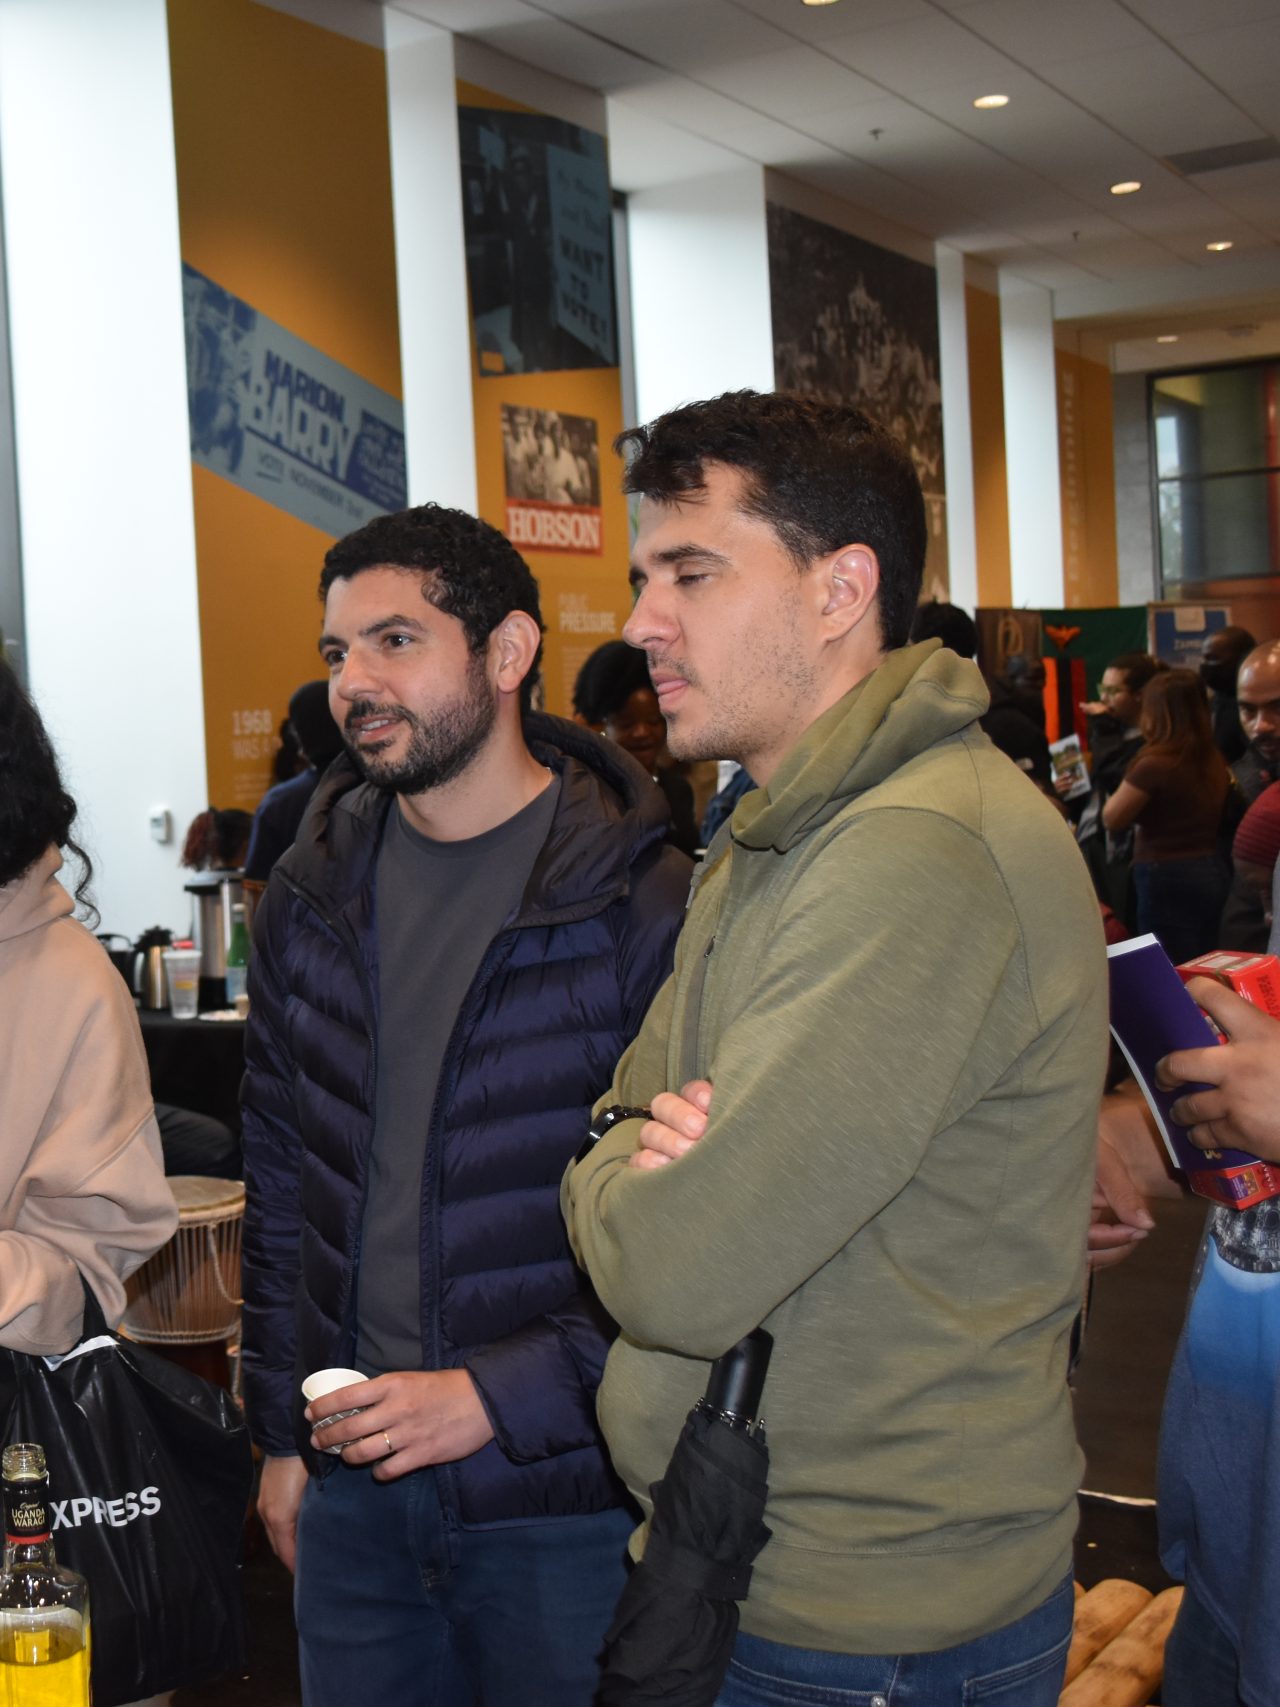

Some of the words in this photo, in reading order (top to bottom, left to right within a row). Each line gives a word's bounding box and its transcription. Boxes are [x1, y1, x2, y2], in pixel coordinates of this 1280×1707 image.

[264, 348, 347, 423] MARION
[240, 376, 358, 483] BARRY
[508, 507, 601, 549] HOBSON
[232, 709, 273, 737] 1968
[11, 1507, 45, 1519] UGANDA
[13, 1516, 45, 1528] WARAGI
[49, 1486, 162, 1531] XPRESS
